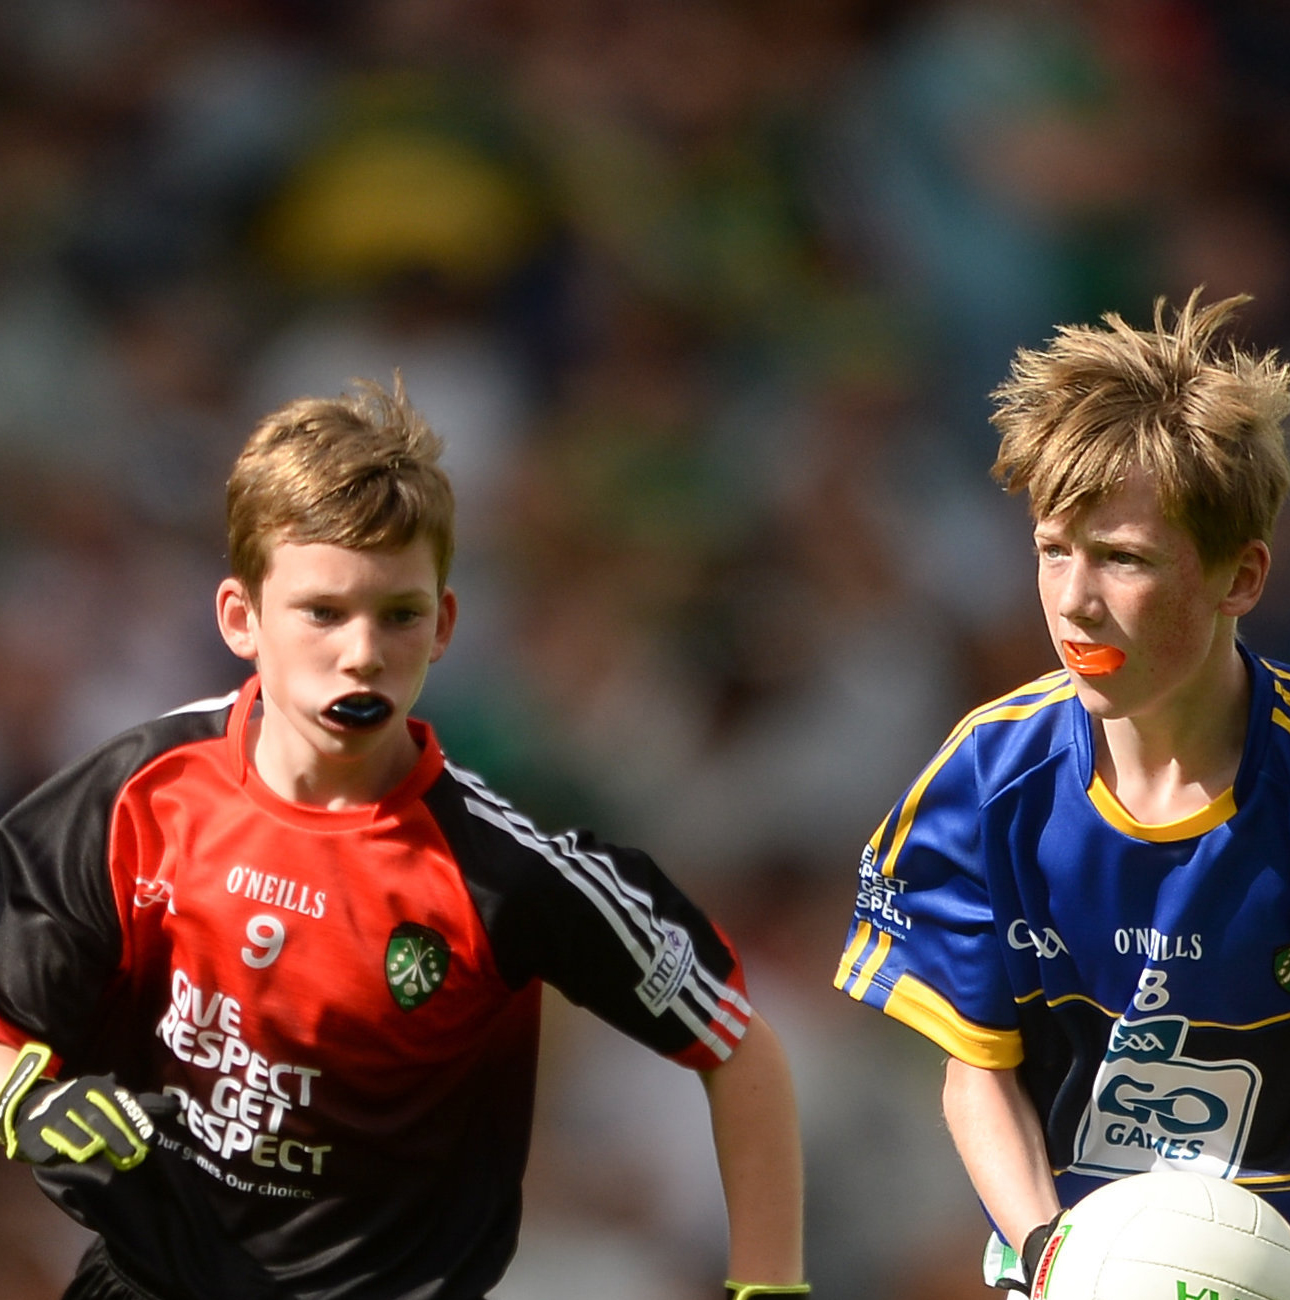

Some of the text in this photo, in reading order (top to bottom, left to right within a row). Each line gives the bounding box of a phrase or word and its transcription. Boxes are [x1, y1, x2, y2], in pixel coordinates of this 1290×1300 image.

[226, 866, 326, 919] O'NEILLS
[859, 863, 908, 894] PECT
[856, 892, 911, 930] SPECT
[241, 915, 285, 969] 9
[172, 969, 241, 1037] GIVE
[1133, 967, 1169, 1011] 8
[155, 1004, 321, 1106] RESPECT
[163, 1086, 331, 1175] RESPECT
[211, 1077, 292, 1134] GET
[1098, 1074, 1228, 1134] GO
[1105, 1123, 1204, 1160] GAMES
[225, 1173, 255, 1193] Our
[258, 1182, 316, 1200] choice.
